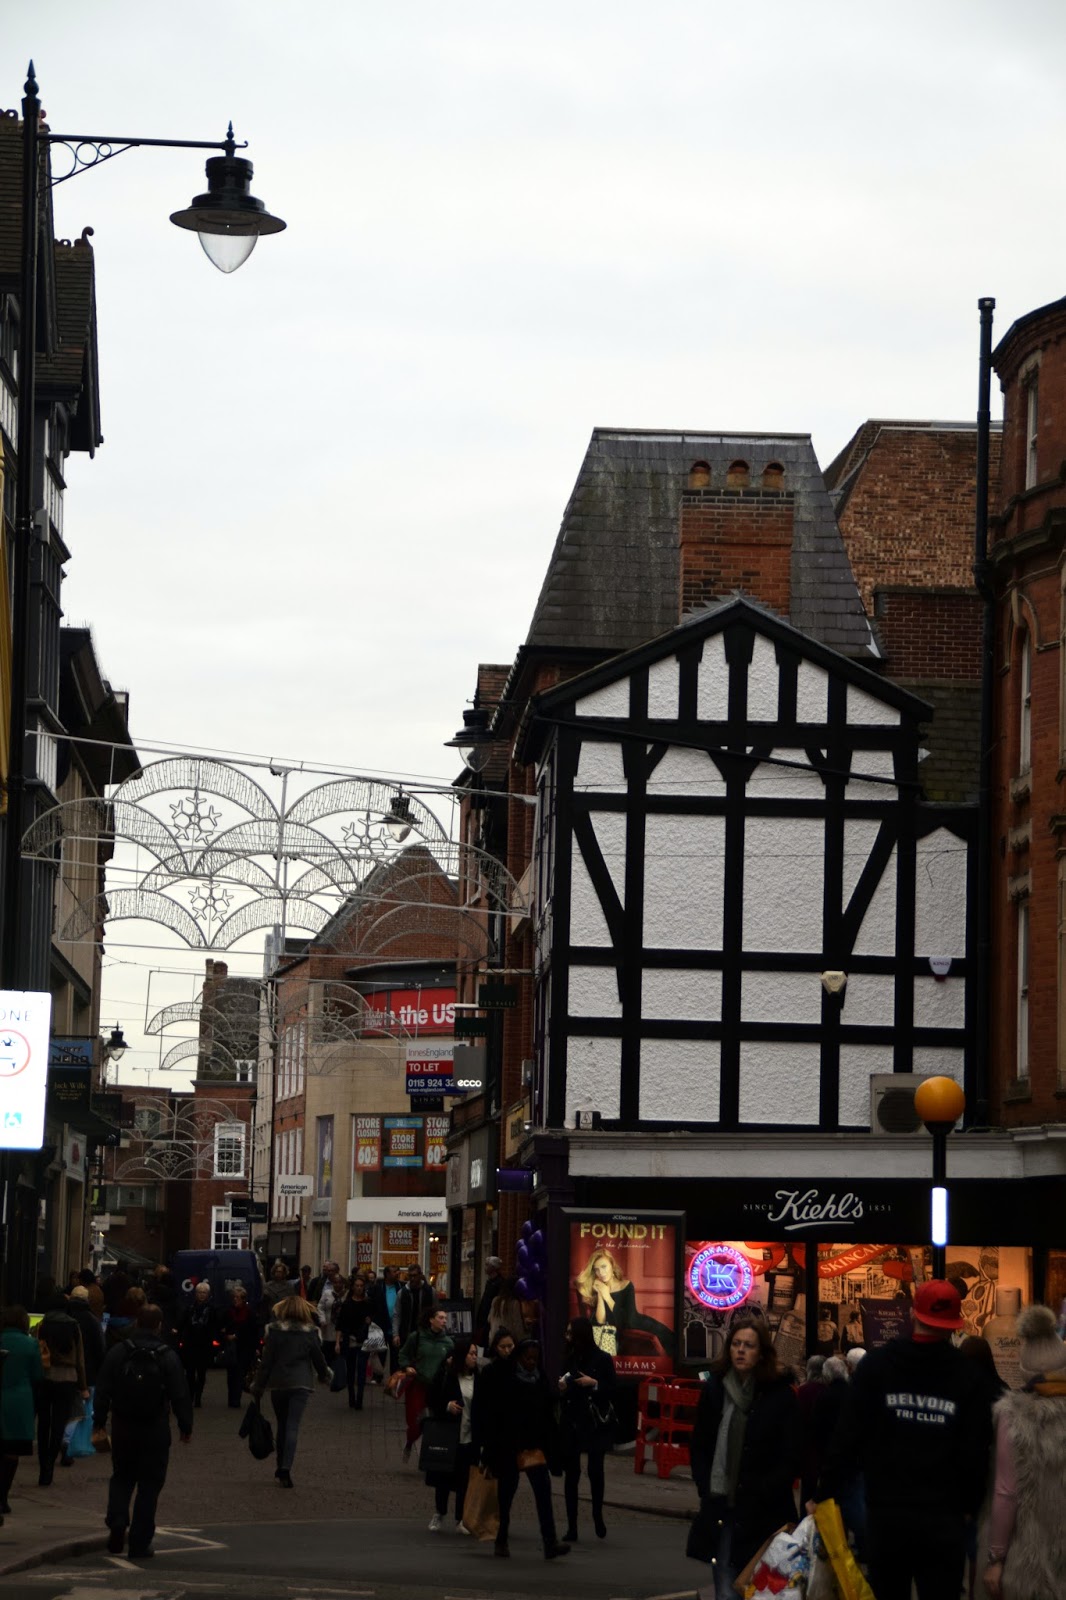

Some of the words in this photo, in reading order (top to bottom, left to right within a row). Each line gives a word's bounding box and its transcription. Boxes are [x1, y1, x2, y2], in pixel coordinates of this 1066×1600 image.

[399, 1005, 429, 1025] the
[408, 1048, 454, 1059] InnesEngland
[409, 1063, 420, 1072] TO
[423, 1063, 440, 1072] LET
[408, 1078, 425, 1088] 0115
[427, 1078, 443, 1087] 924
[457, 1079, 483, 1088] ecco
[357, 1118, 380, 1128] STORE
[427, 1117, 450, 1127] STOR
[357, 1129, 380, 1137] CLOSING
[427, 1128, 449, 1136] CLOSIN
[392, 1135, 415, 1143] STORE
[767, 1189, 864, 1221] Kiehl's
[868, 1204, 892, 1212] 1851
[389, 1230, 413, 1239] STORE
[580, 1222, 648, 1239] FOUND
[651, 1224, 667, 1240] IT
[605, 1240, 616, 1248] the
[691, 1267, 699, 1287] NEW
[695, 1247, 715, 1265] YORK
[716, 1246, 751, 1291] APOTHECARY
[700, 1292, 724, 1305] SINCE
[726, 1291, 743, 1304] 1851
[886, 1393, 956, 1414] BELVOIR
[895, 1409, 914, 1419] TRI
[916, 1412, 945, 1423] CLUB
